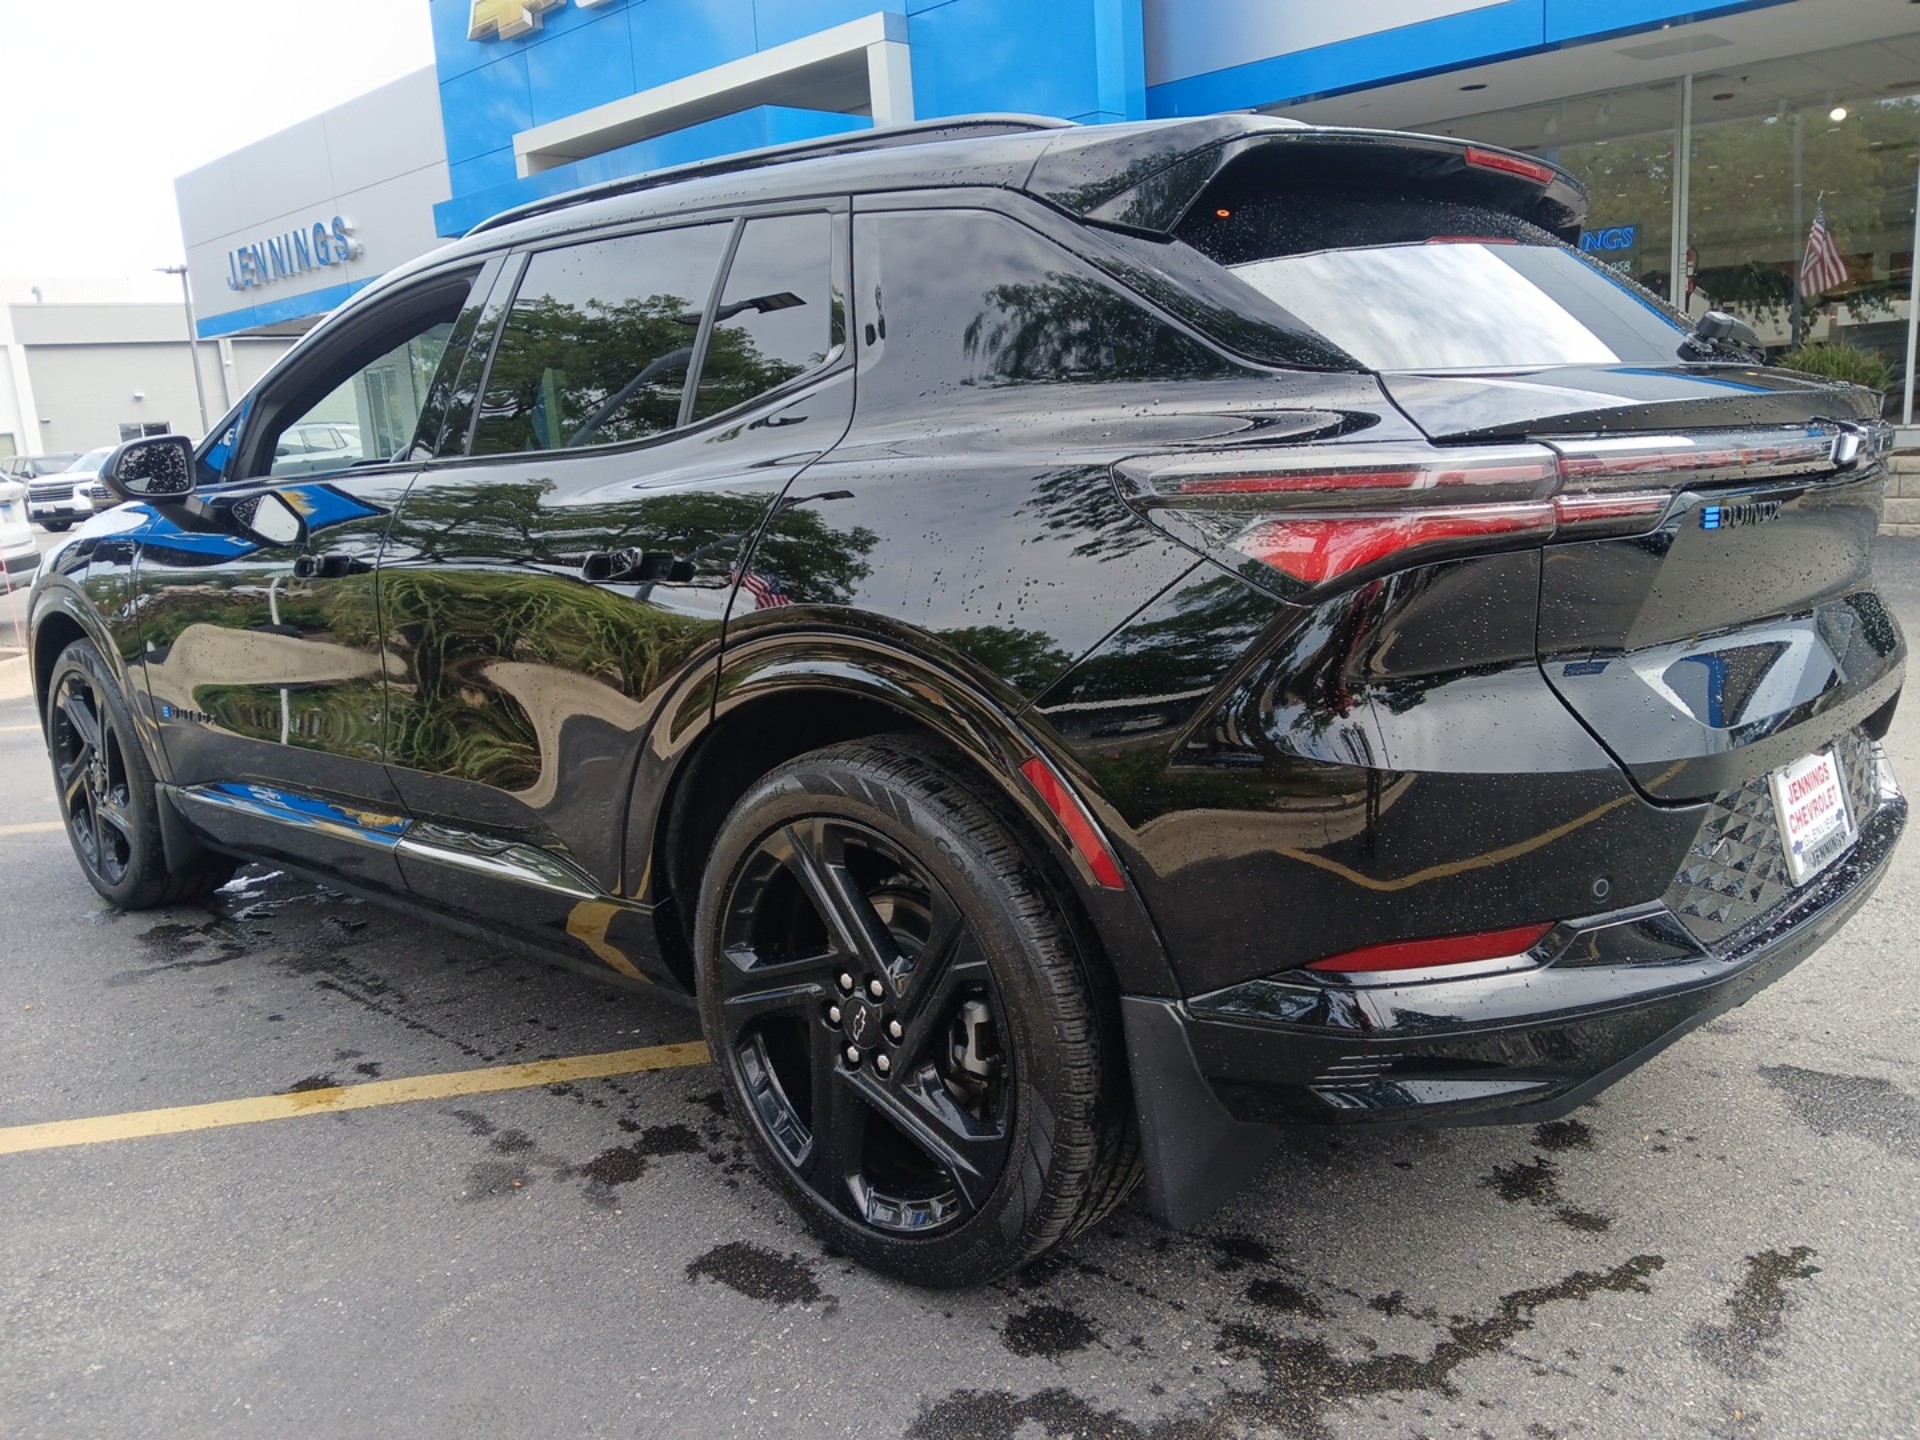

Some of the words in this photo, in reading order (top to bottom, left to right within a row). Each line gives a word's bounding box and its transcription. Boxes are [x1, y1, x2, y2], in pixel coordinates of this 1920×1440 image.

[227, 216, 354, 291] JENNINGS
[1701, 500, 1782, 530] EQUINOX
[1788, 762, 1830, 805] JENNINGS
[1789, 785, 1838, 834] CHEVROLET
